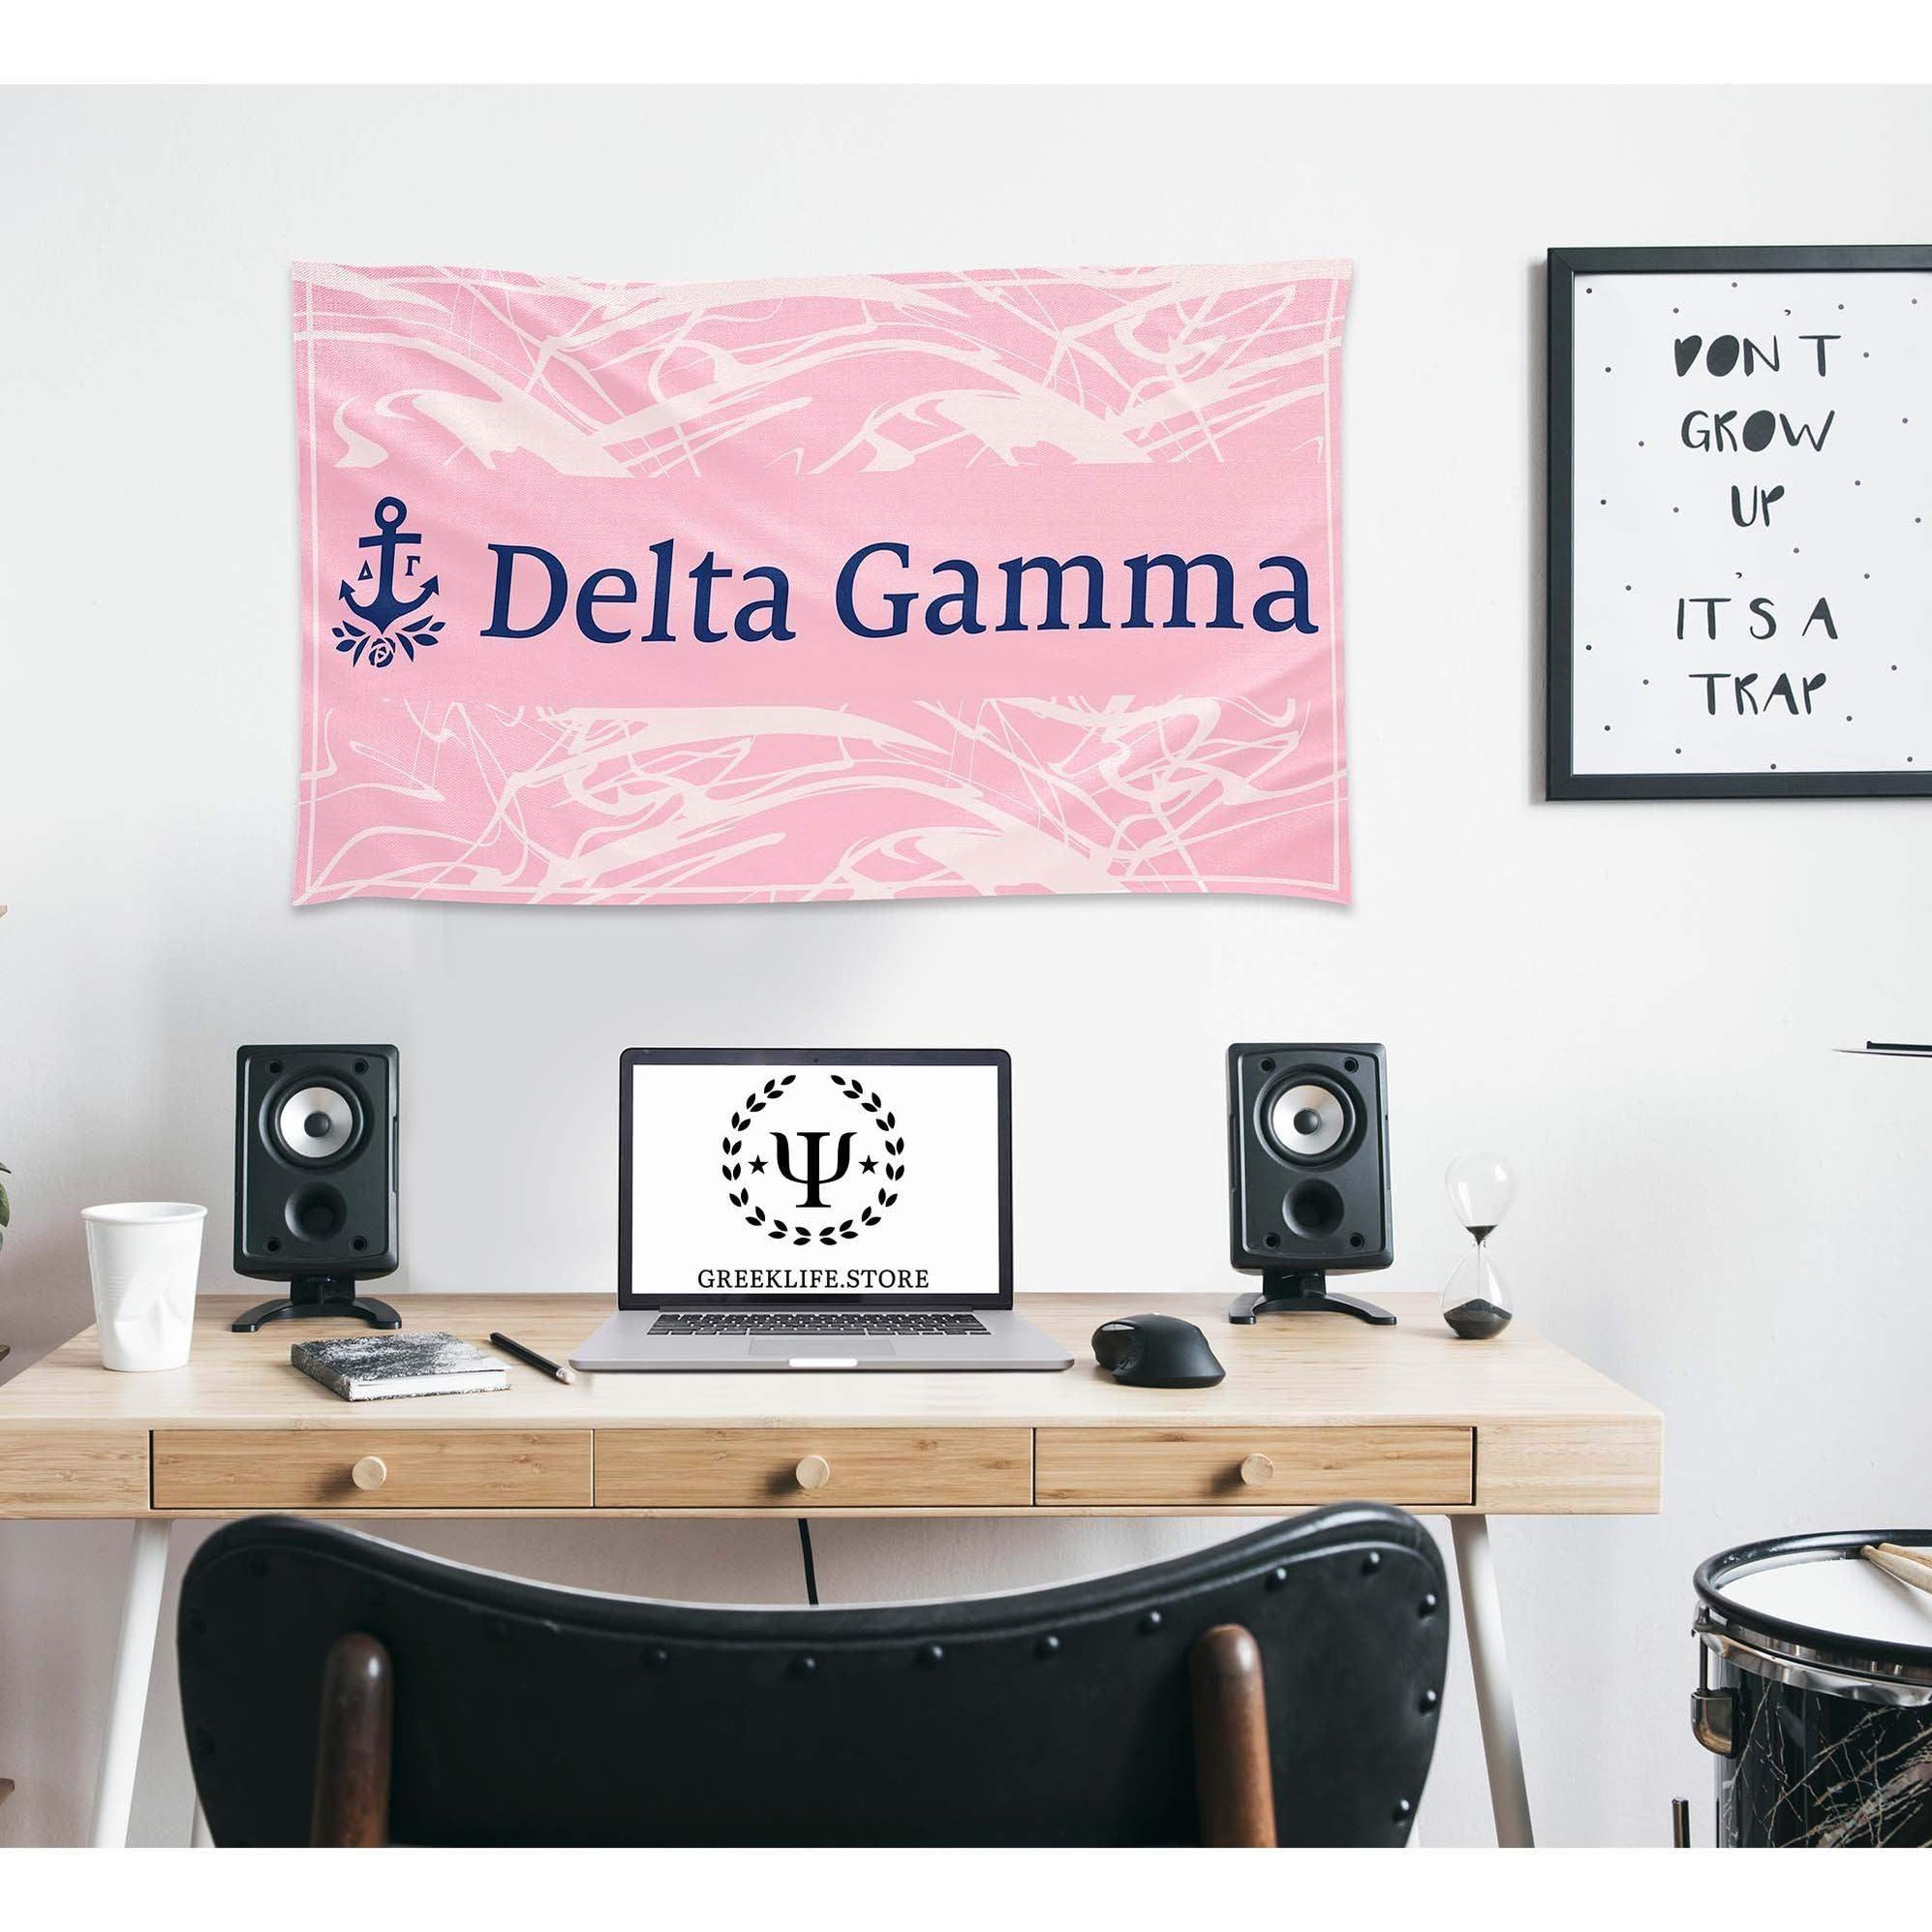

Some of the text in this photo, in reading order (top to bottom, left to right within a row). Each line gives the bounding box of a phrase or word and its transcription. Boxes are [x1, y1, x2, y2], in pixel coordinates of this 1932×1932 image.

[1680, 410, 1835, 452] GROW
[1731, 484, 1785, 528] UP
[479, 537, 1320, 644] Delta Gamma
[1801, 597, 1839, 640] A
[1688, 672, 1827, 716] TRAP
[697, 1269, 930, 1289] GREEKLIFE.STORE
